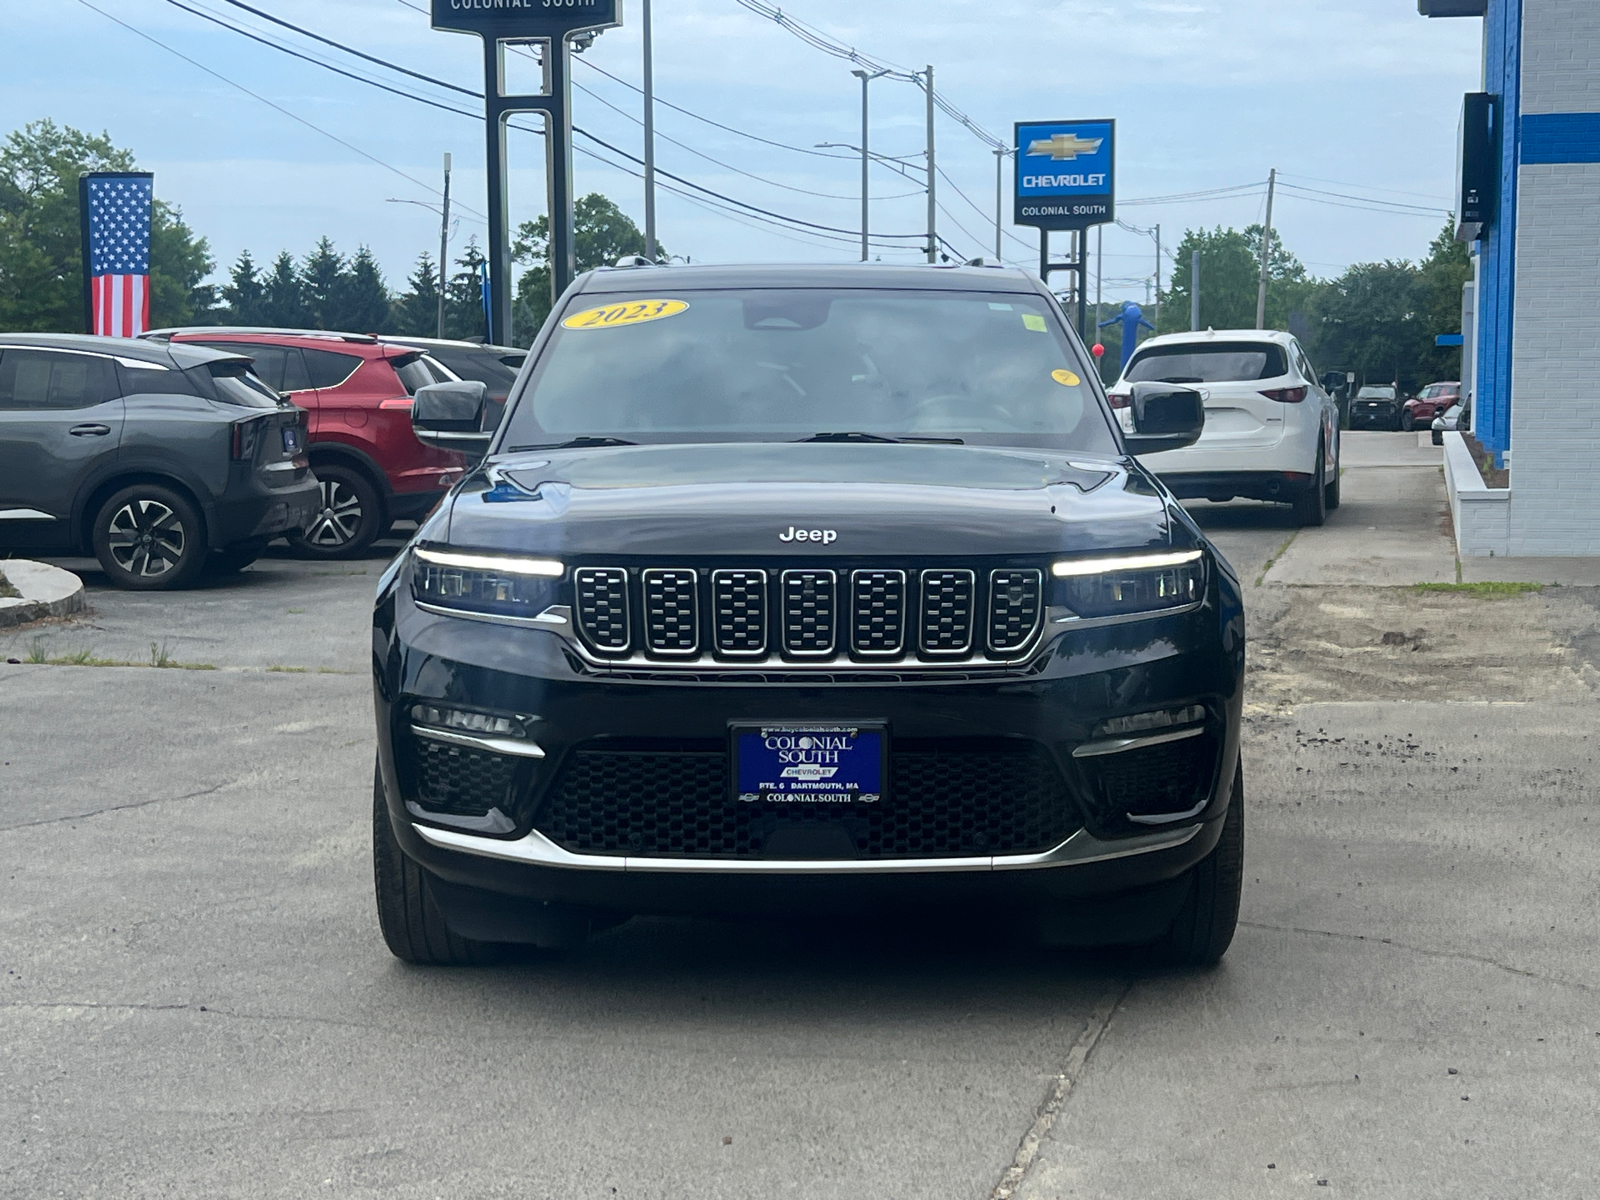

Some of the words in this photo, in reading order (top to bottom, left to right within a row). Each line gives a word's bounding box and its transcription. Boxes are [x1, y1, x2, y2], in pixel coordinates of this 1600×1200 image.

[451, 0, 531, 9] COLONIAL
[1023, 174, 1106, 187] CHEVROLET
[1021, 206, 1070, 216] COLONIAL
[1073, 205, 1106, 215] SOUTH
[581, 302, 668, 326] 2023
[779, 526, 837, 544] Jeep
[765, 736, 853, 750] COLONIAL
[778, 750, 839, 763] SOUTH
[766, 794, 818, 803] COLONIAL
[818, 794, 851, 803] SOUTH
